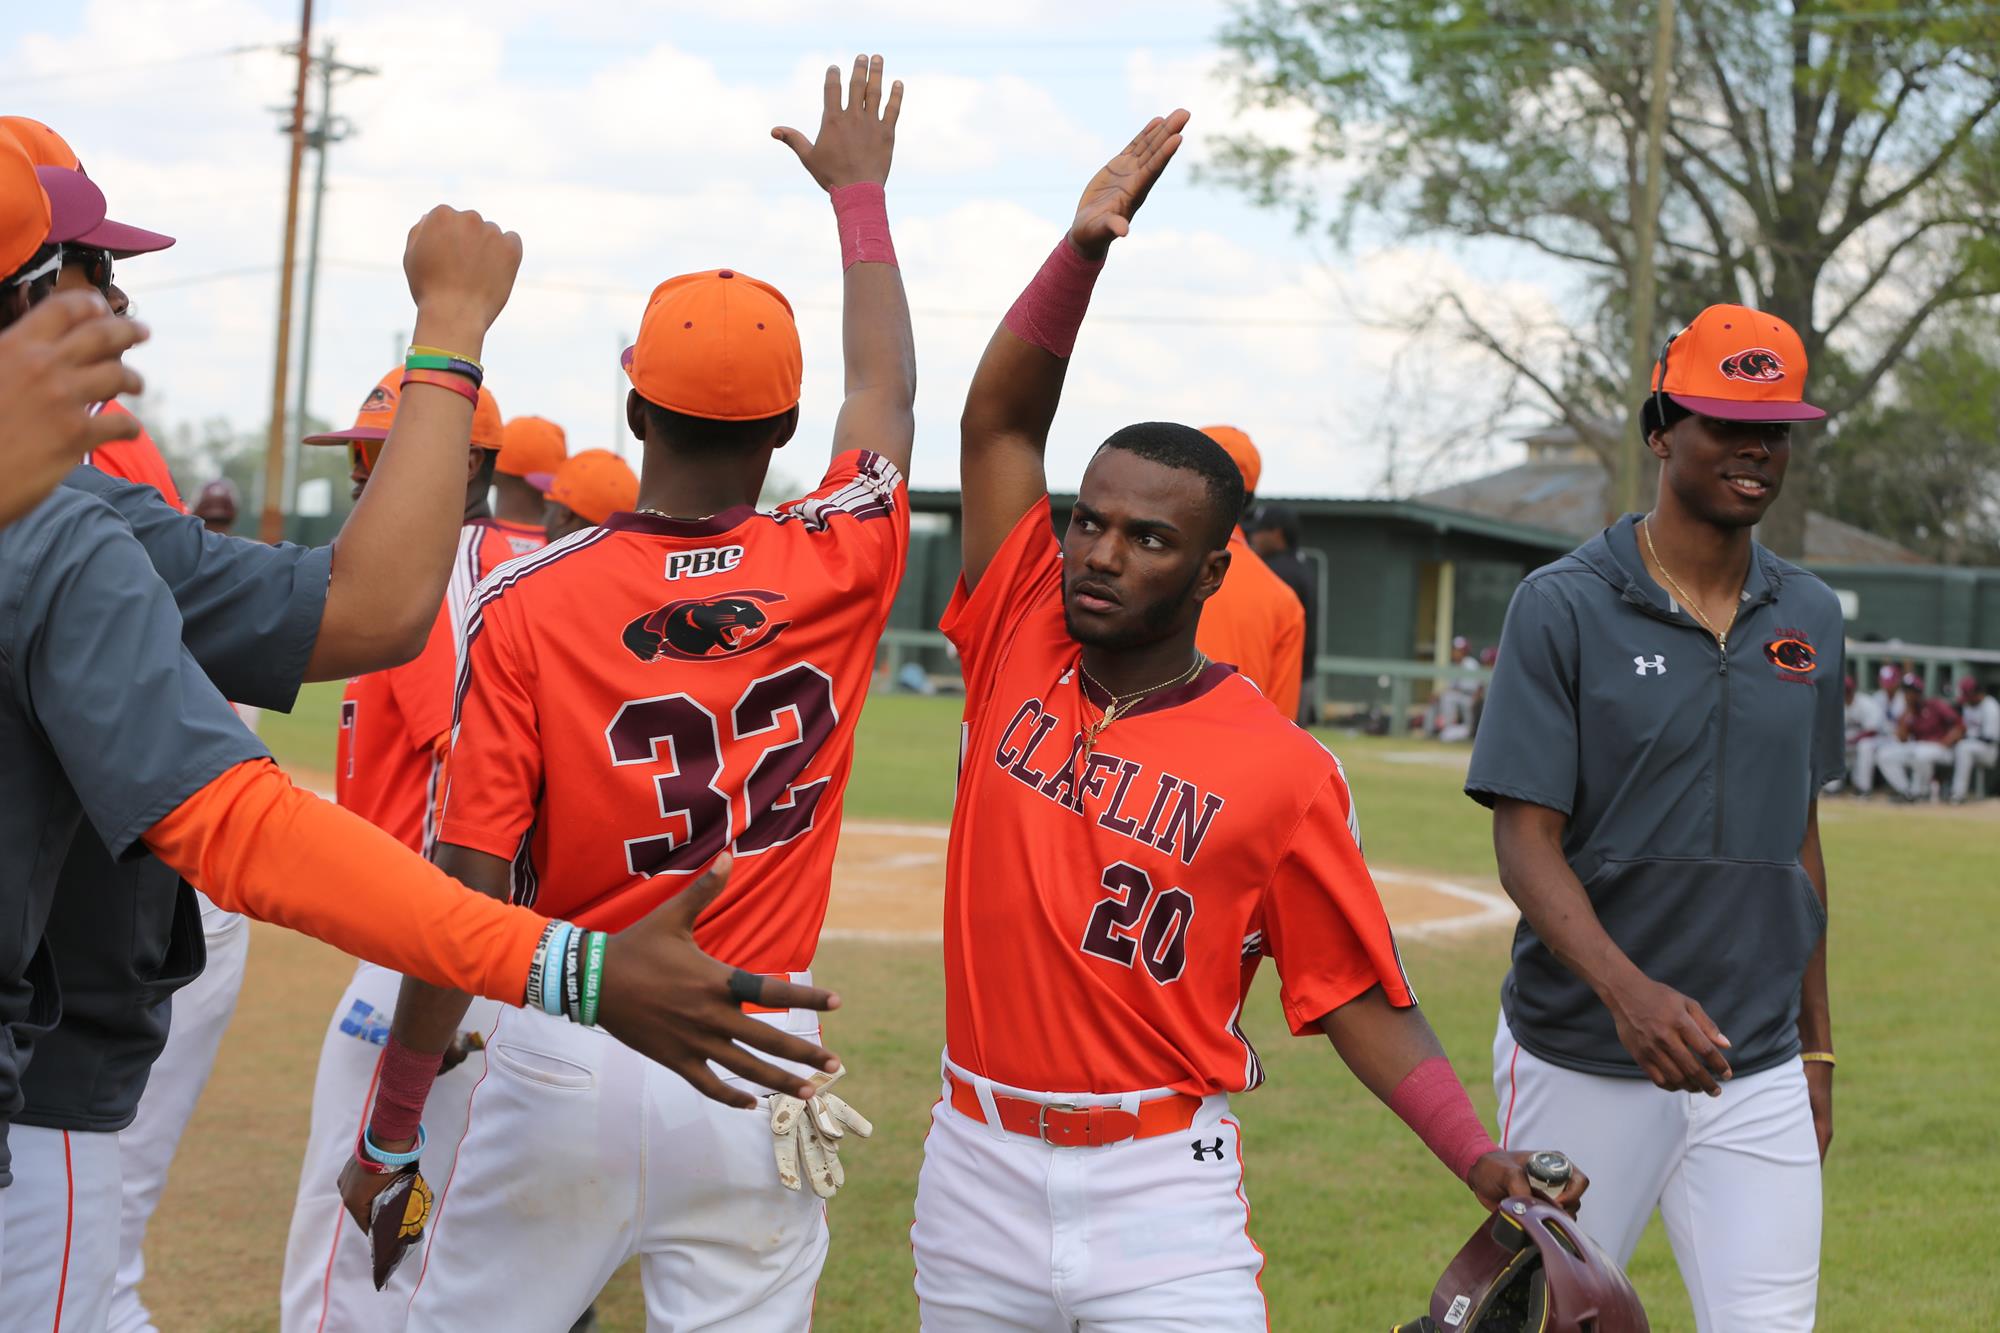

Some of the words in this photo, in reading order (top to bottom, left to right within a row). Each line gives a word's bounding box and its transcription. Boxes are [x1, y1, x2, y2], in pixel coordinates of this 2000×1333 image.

[664, 545, 743, 580] PBC
[605, 661, 839, 880] 32
[1080, 860, 1194, 986] 20
